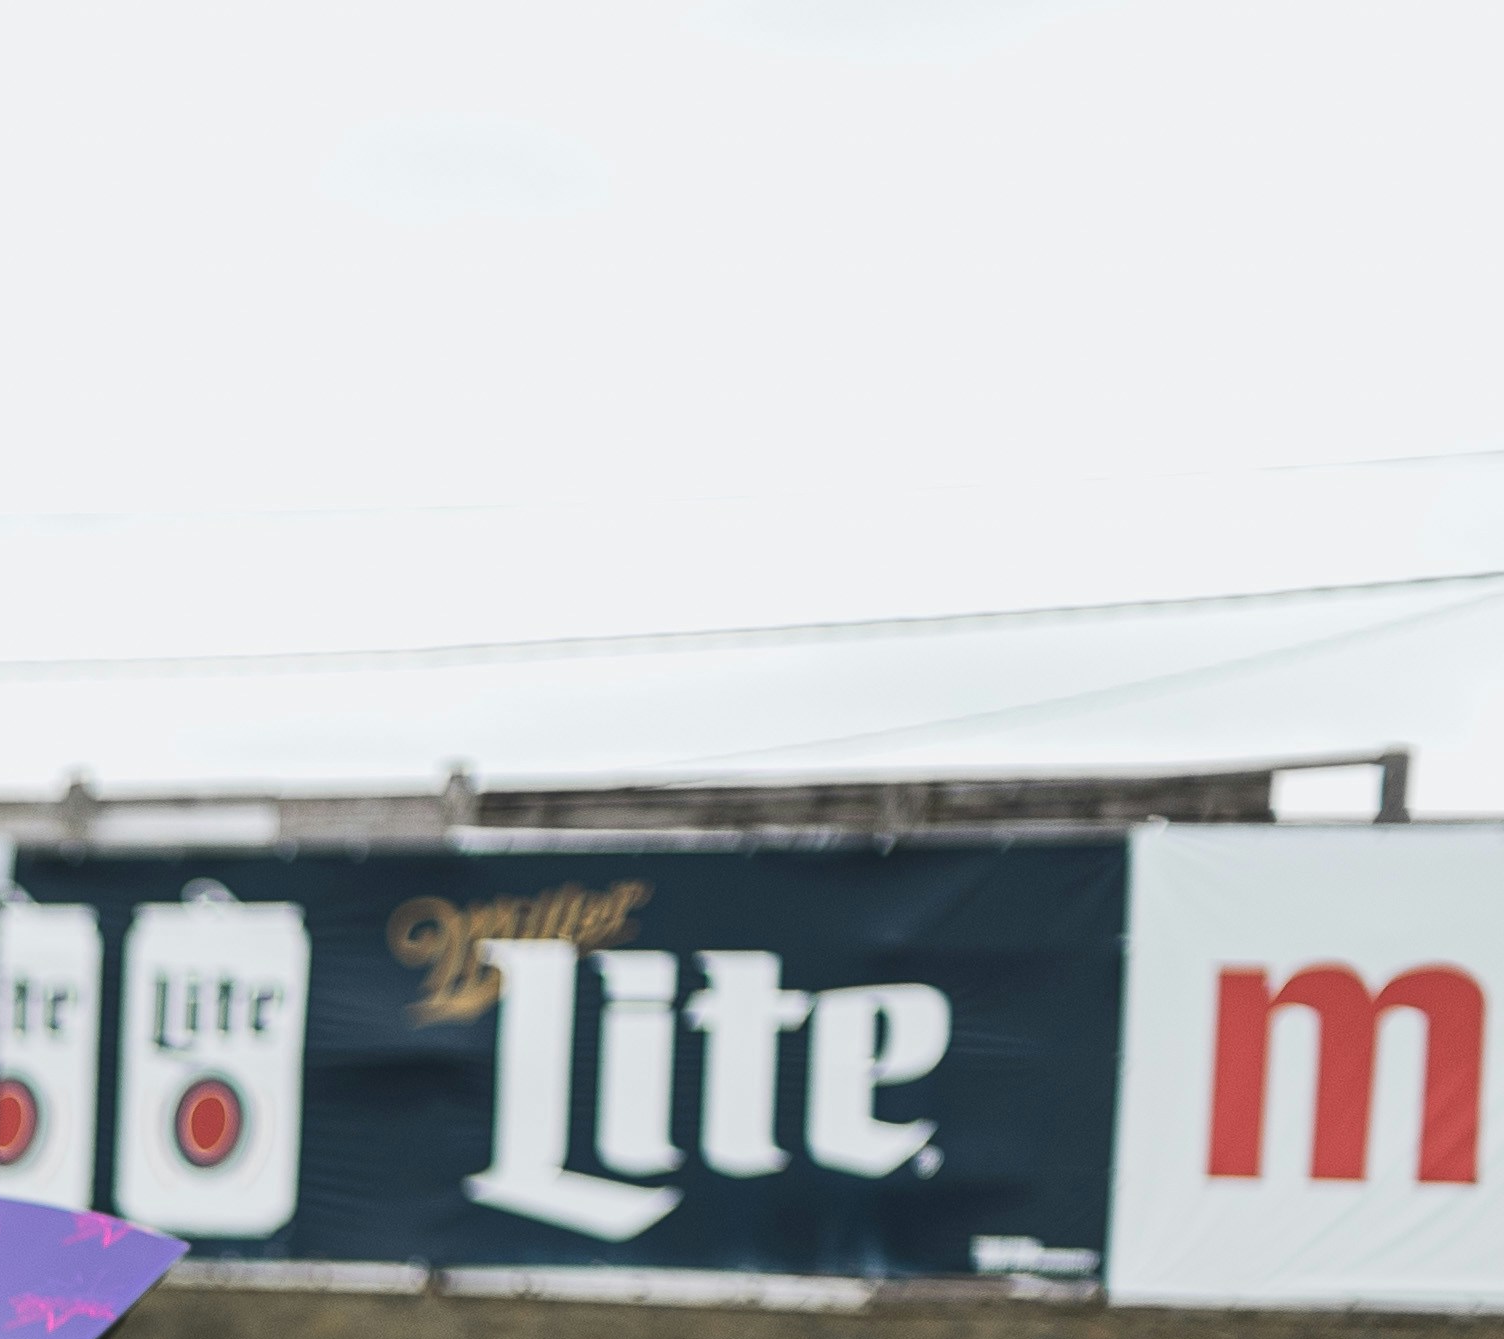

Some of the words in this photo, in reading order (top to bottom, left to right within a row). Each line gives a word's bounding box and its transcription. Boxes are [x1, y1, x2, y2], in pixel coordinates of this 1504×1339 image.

[151, 973, 284, 1050] Lite
[463, 938, 952, 1242] Lite
[1207, 962, 1487, 1184] m
